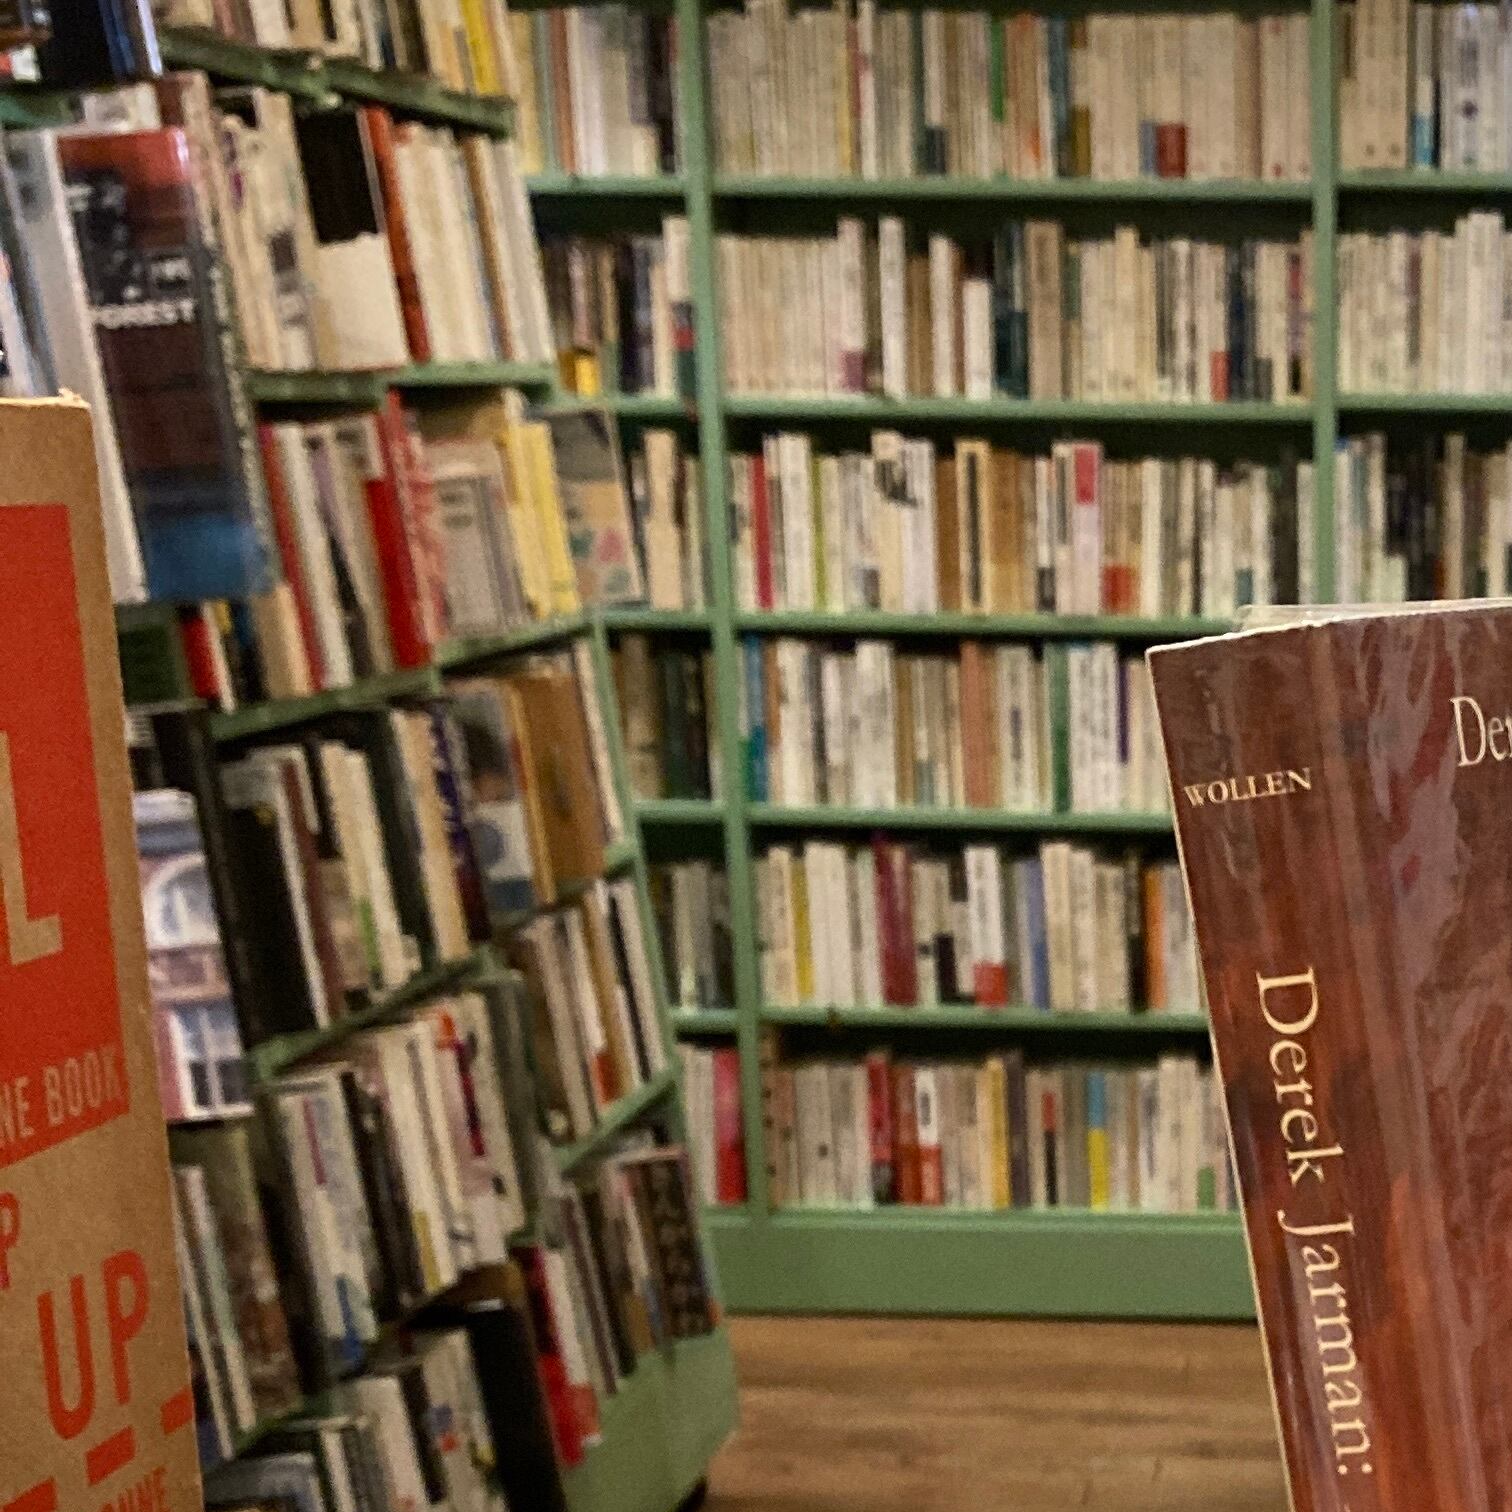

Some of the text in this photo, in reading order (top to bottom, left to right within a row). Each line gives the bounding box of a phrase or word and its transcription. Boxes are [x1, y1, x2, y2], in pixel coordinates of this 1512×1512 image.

[1184, 766, 1312, 808] WOLLEN
[43, 1045, 122, 1127] BOOK
[1256, 966, 1344, 1187] Derek
[37, 1249, 150, 1440] UP
[1277, 1209, 1375, 1475] Jarman:
